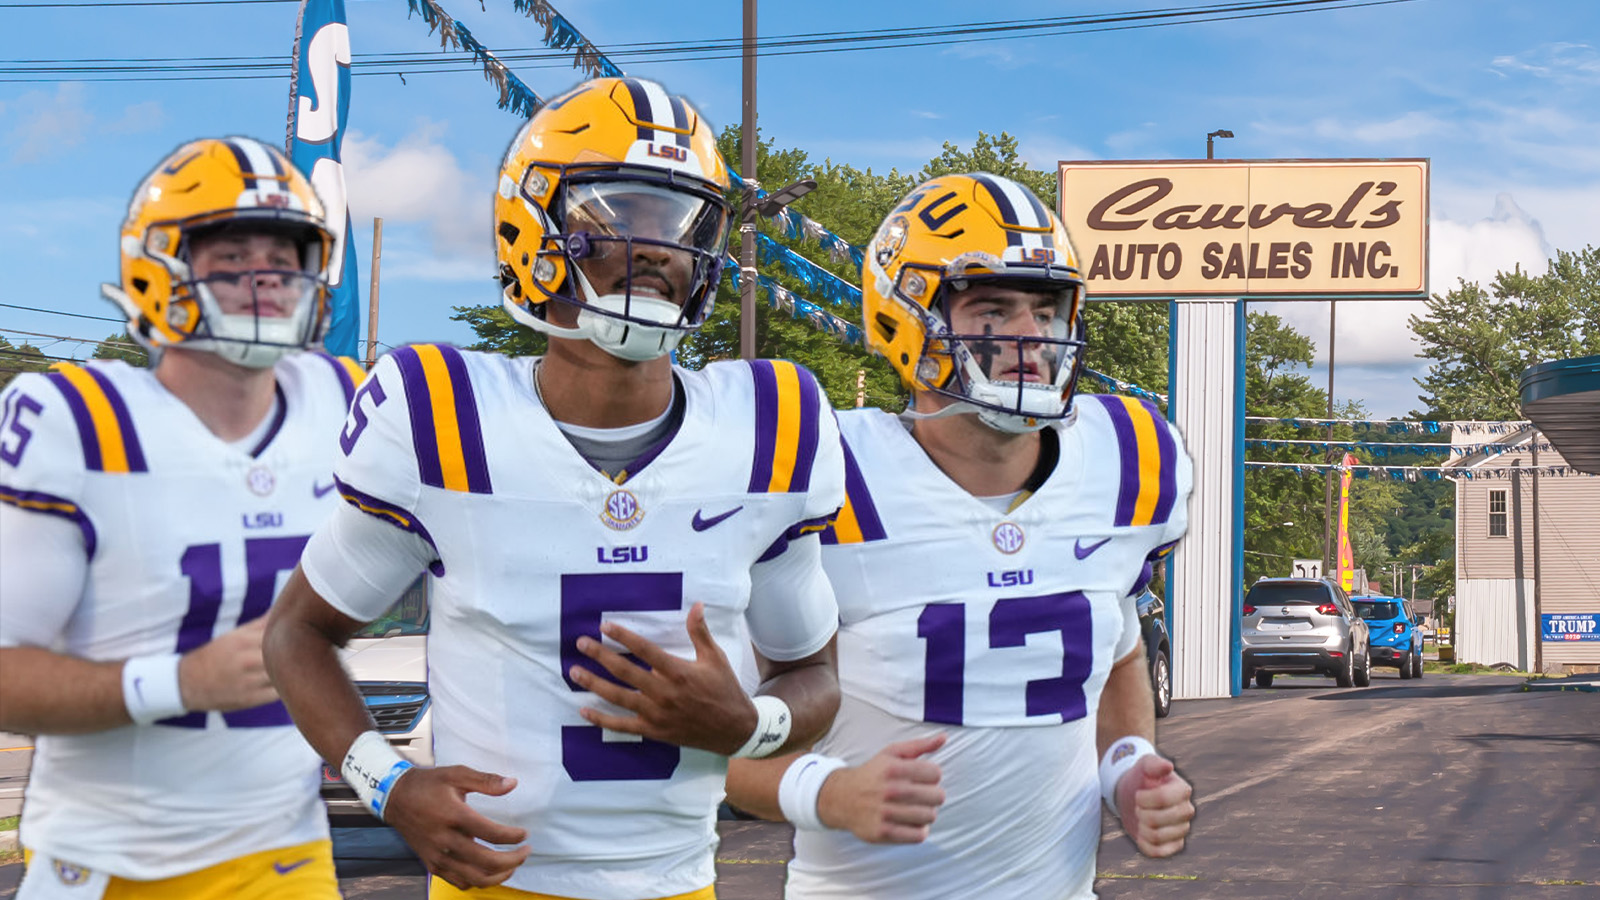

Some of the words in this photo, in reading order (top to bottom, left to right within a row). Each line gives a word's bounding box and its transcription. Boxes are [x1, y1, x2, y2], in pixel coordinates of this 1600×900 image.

[647, 142, 687, 163] LSU
[1086, 177, 1405, 231] Cauvel's
[1020, 247, 1057, 265] LSU
[1086, 241, 1183, 281] AUTO
[1200, 241, 1313, 280] SALES
[1329, 240, 1399, 279] INC.
[608, 491, 635, 519] SEC
[242, 512, 283, 528] LSU
[996, 524, 1023, 552] SEC
[596, 545, 649, 564] LSU
[987, 569, 1034, 588] LSU
[1548, 620, 1596, 633] TRUMP
[917, 590, 1094, 726] 13
[559, 571, 684, 782] 5
